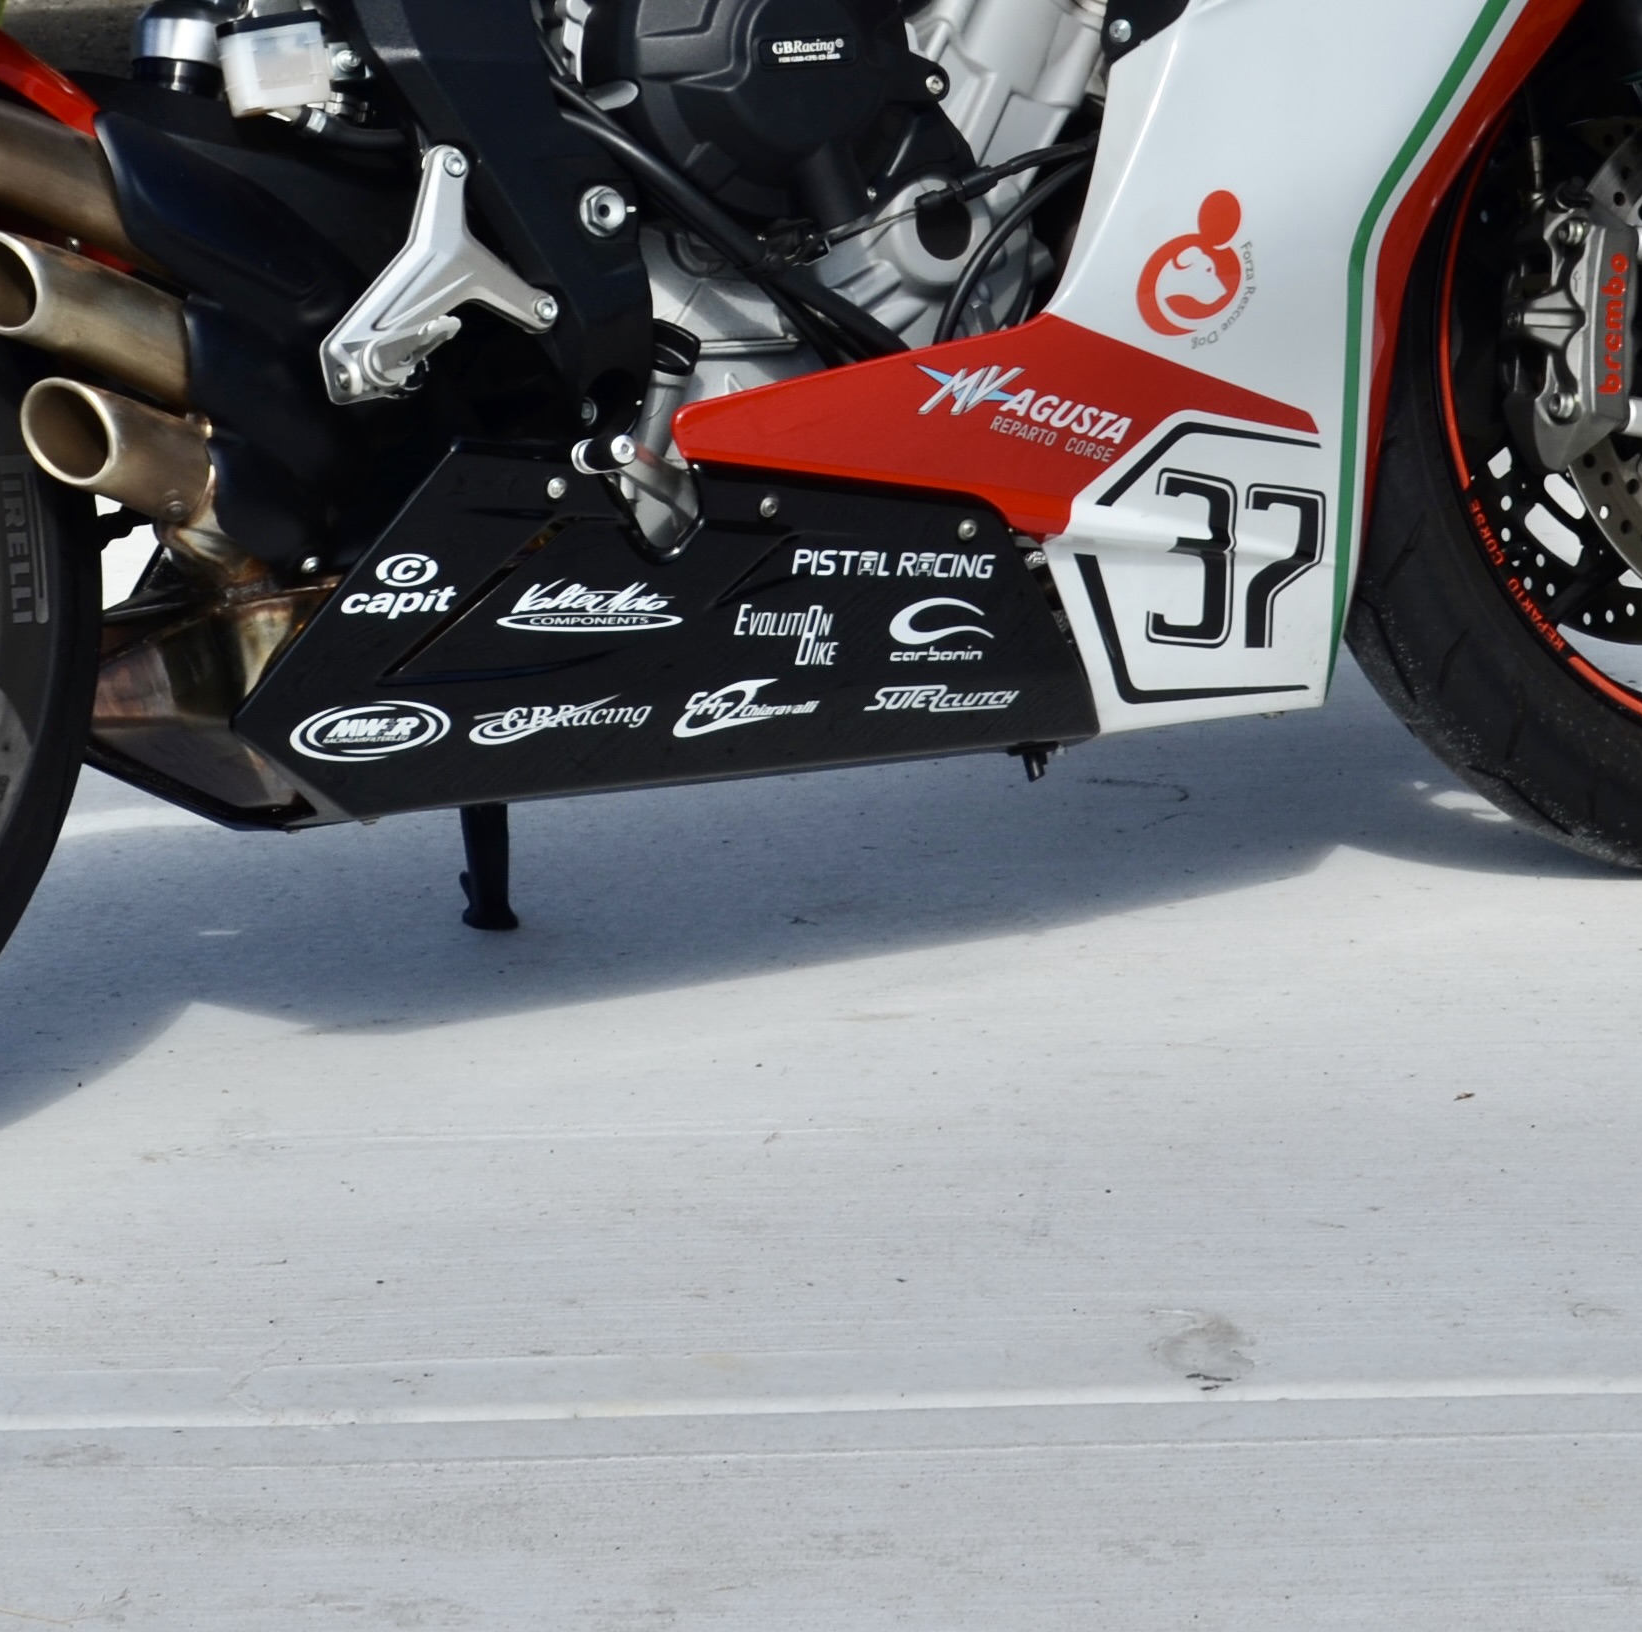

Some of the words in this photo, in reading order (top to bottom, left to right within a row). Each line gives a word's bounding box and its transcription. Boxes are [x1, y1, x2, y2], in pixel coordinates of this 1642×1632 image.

[1240, 241, 1255, 281] Forza
[1221, 286, 1257, 331] Rescue
[1597, 252, 1629, 395] brembo
[1191, 330, 1218, 350] Dog
[917, 364, 1025, 415] MV
[998, 388, 1132, 445] AGUSTA
[990, 415, 1058, 447] REPARTO
[1065, 436, 1115, 463] CORSE
[1468, 497, 1506, 566] CORSE
[1145, 466, 1327, 650] 37
[340, 585, 458, 619] capit
[528, 615, 650, 627] COMPONENTS
[1508, 576, 1566, 652] REPARTO
[888, 645, 984, 662] carbonin
[501, 703, 653, 729] GBRacing
[738, 700, 821, 718] Chiaravalli
